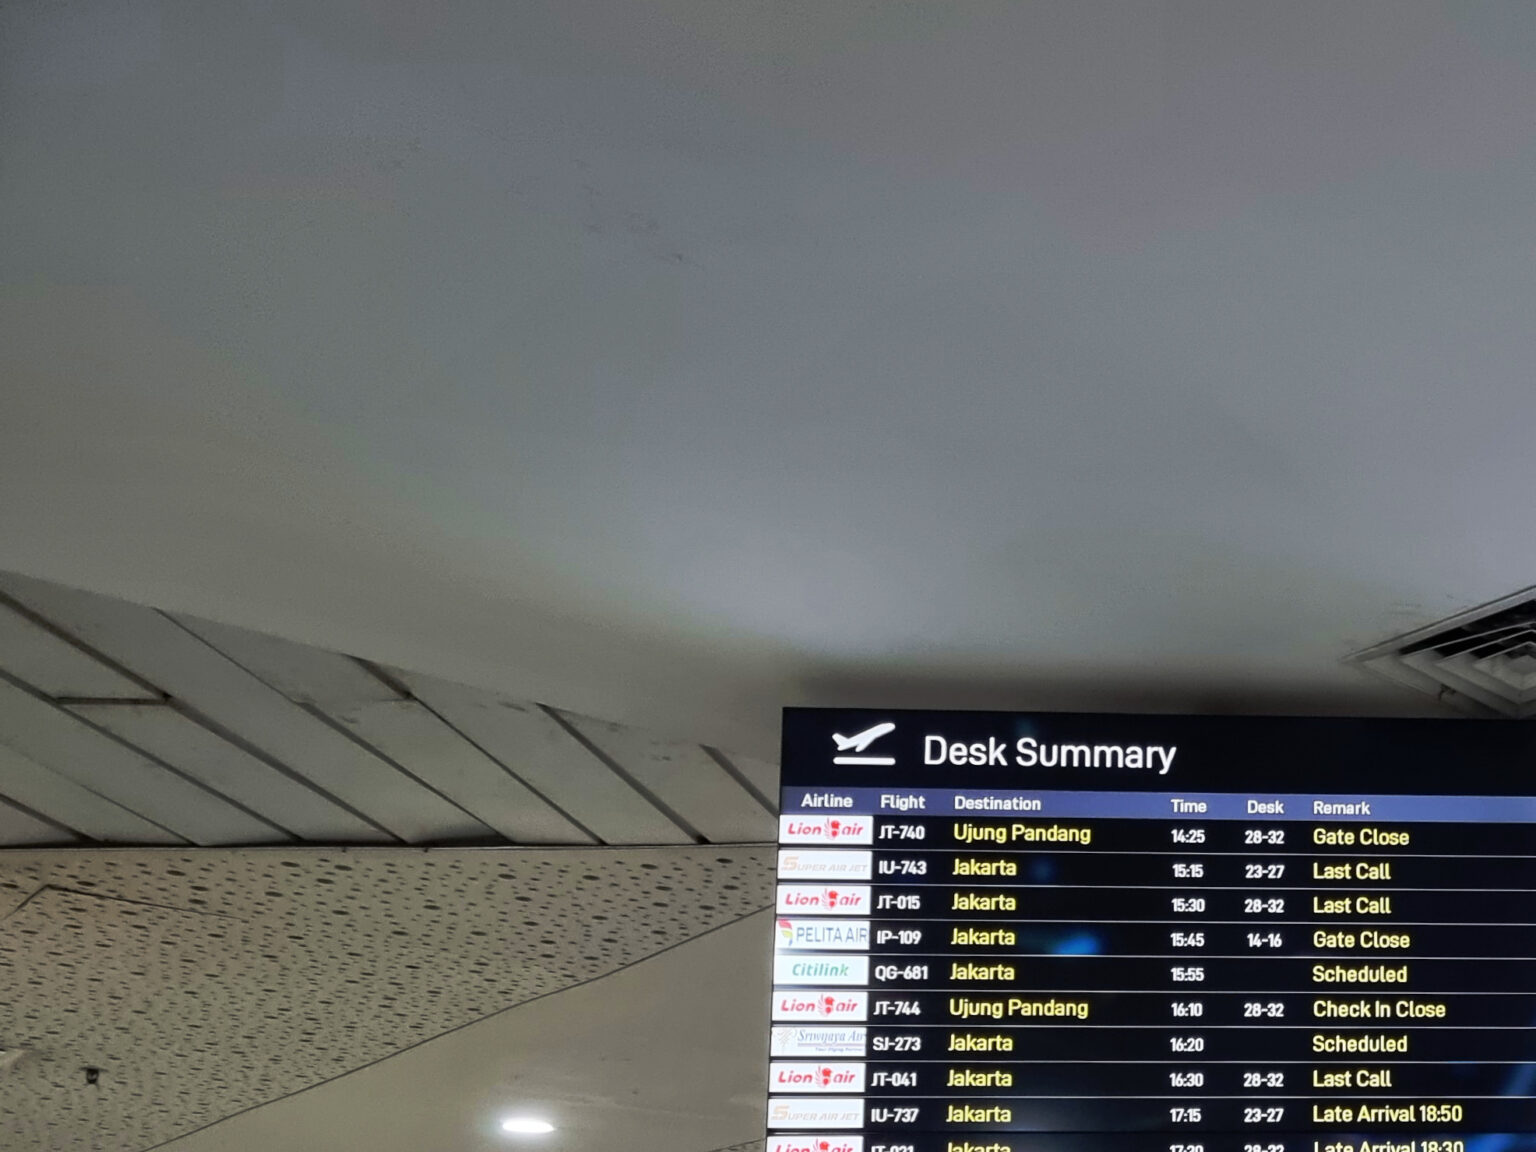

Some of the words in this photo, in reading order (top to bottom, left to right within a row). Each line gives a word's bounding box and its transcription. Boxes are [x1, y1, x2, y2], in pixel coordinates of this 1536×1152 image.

[924, 735, 1008, 766] Desk
[1015, 736, 1177, 775] Summary
[801, 793, 852, 807] Airline
[880, 794, 925, 810] Flight
[954, 795, 1041, 810] Destination
[1170, 798, 1206, 812] Time
[1247, 799, 1283, 813] Desk
[1313, 800, 1370, 814] Remark
[787, 822, 822, 835] Lion
[841, 822, 864, 835] air
[879, 825, 925, 839] JT-740
[954, 824, 1006, 843] Ujung
[1012, 824, 1090, 844] Pandang
[1171, 829, 1205, 843] 14:25
[1245, 830, 1284, 844] 28-32
[1314, 828, 1354, 845] Gate
[1360, 829, 1409, 845] Close
[796, 926, 843, 943] PELITA
[845, 926, 868, 942] AIR
[877, 930, 921, 944] IP-109
[951, 928, 1015, 945] Jakarta
[1171, 933, 1204, 946] 15:45
[1247, 933, 1282, 947] 14-16
[1314, 931, 1355, 947] Gate
[1360, 931, 1410, 948] Close
[873, 1037, 921, 1051] SJ-273
[948, 1034, 1012, 1051] Jakarta
[1170, 1038, 1204, 1051] 16:20
[1313, 1035, 1407, 1052] Scheduled
[771, 1105, 818, 1121] SUPER
[819, 1112, 838, 1121] AIR
[839, 1112, 860, 1121] JET
[871, 1108, 919, 1122] IU-737
[946, 1105, 1011, 1122] Jakarta
[1170, 1108, 1201, 1122] 17:15
[1244, 1108, 1284, 1122] 23-27
[1313, 1105, 1352, 1122] Late
[1357, 1105, 1416, 1122] Arrival
[1420, 1105, 1462, 1122] 18:50
